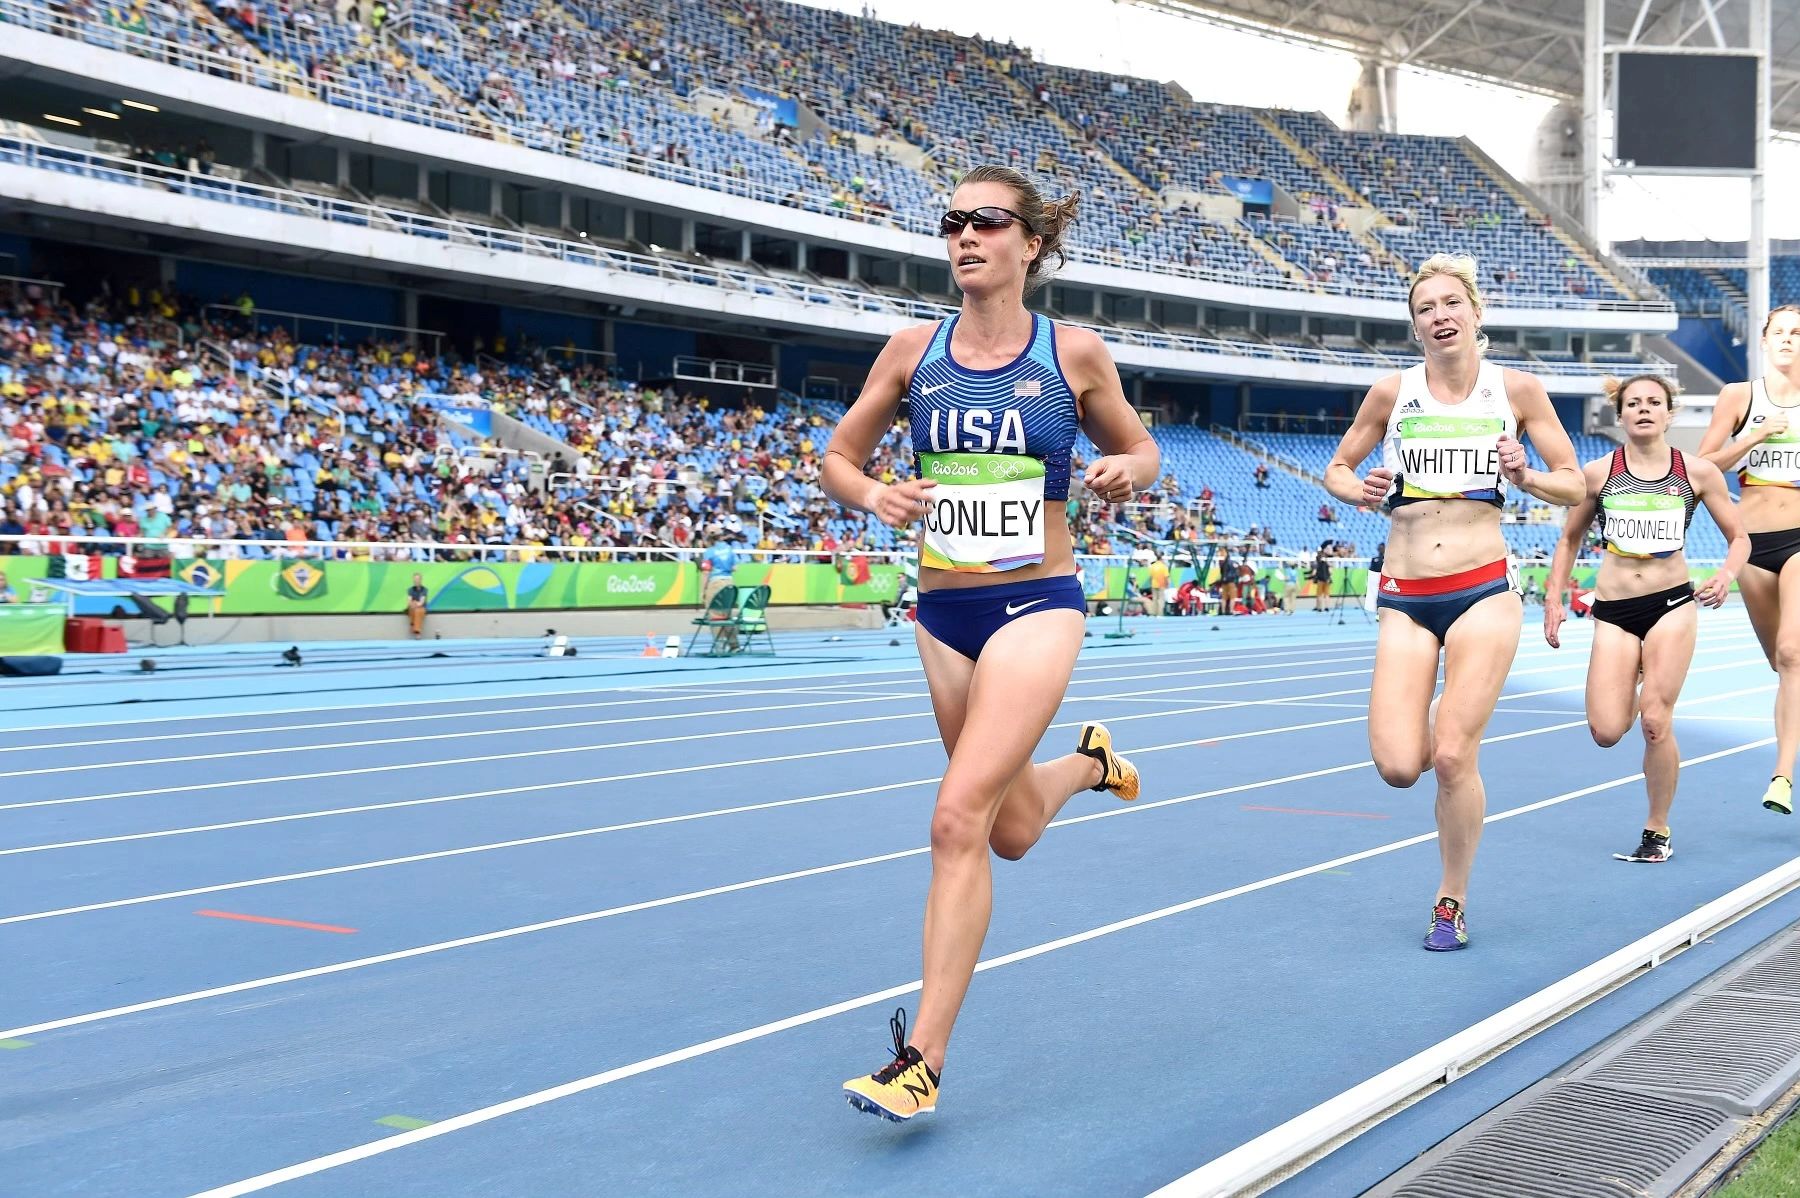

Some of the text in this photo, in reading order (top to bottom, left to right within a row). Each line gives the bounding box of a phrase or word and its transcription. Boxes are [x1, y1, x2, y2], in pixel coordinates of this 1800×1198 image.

[930, 409, 1027, 454] USA
[931, 460, 979, 476] Rio2016
[1401, 448, 1499, 475] WHITTLE
[607, 574, 656, 593] Rio2016
